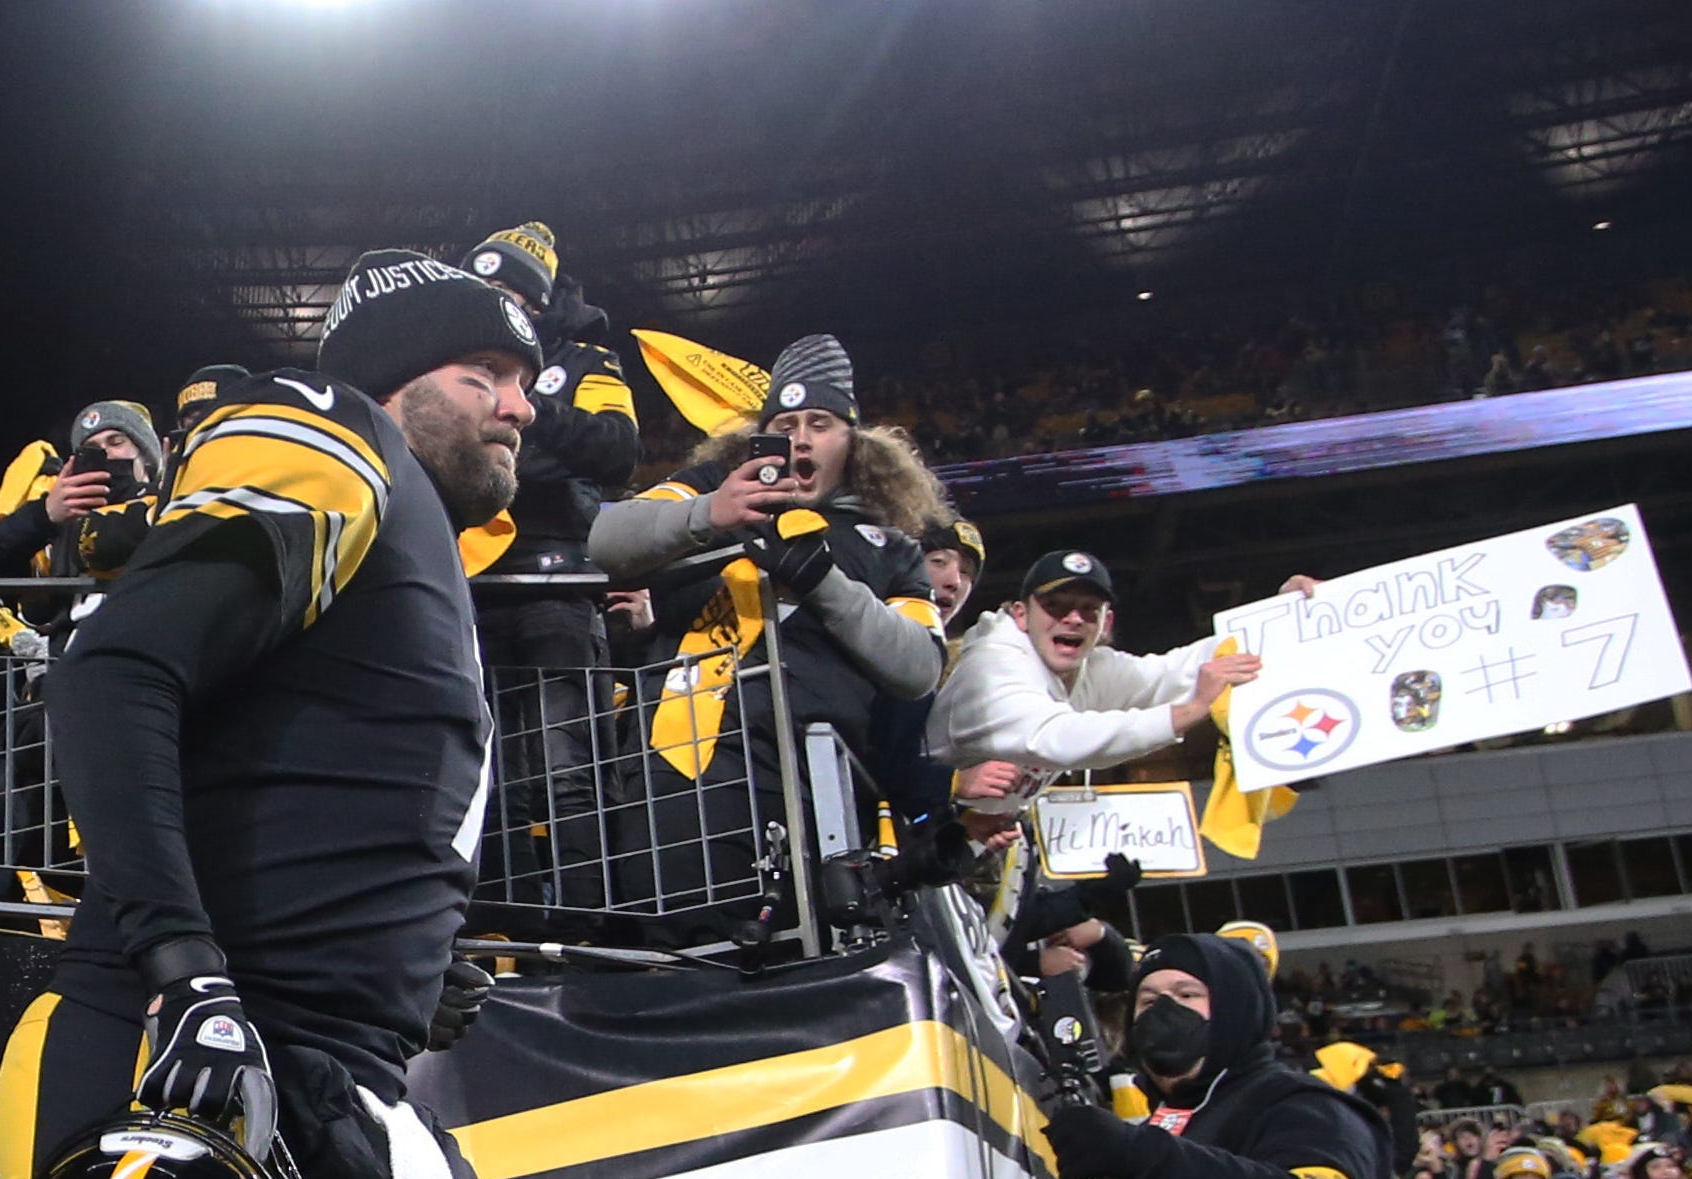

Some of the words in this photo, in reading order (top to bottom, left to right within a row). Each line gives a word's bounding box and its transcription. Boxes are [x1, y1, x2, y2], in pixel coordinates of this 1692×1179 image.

[1227, 552, 1491, 657] Thank
[1366, 599, 1501, 675] you
[1459, 646, 1538, 703] #
[1560, 612, 1639, 690] 7
[1046, 816, 1084, 856] Hi
